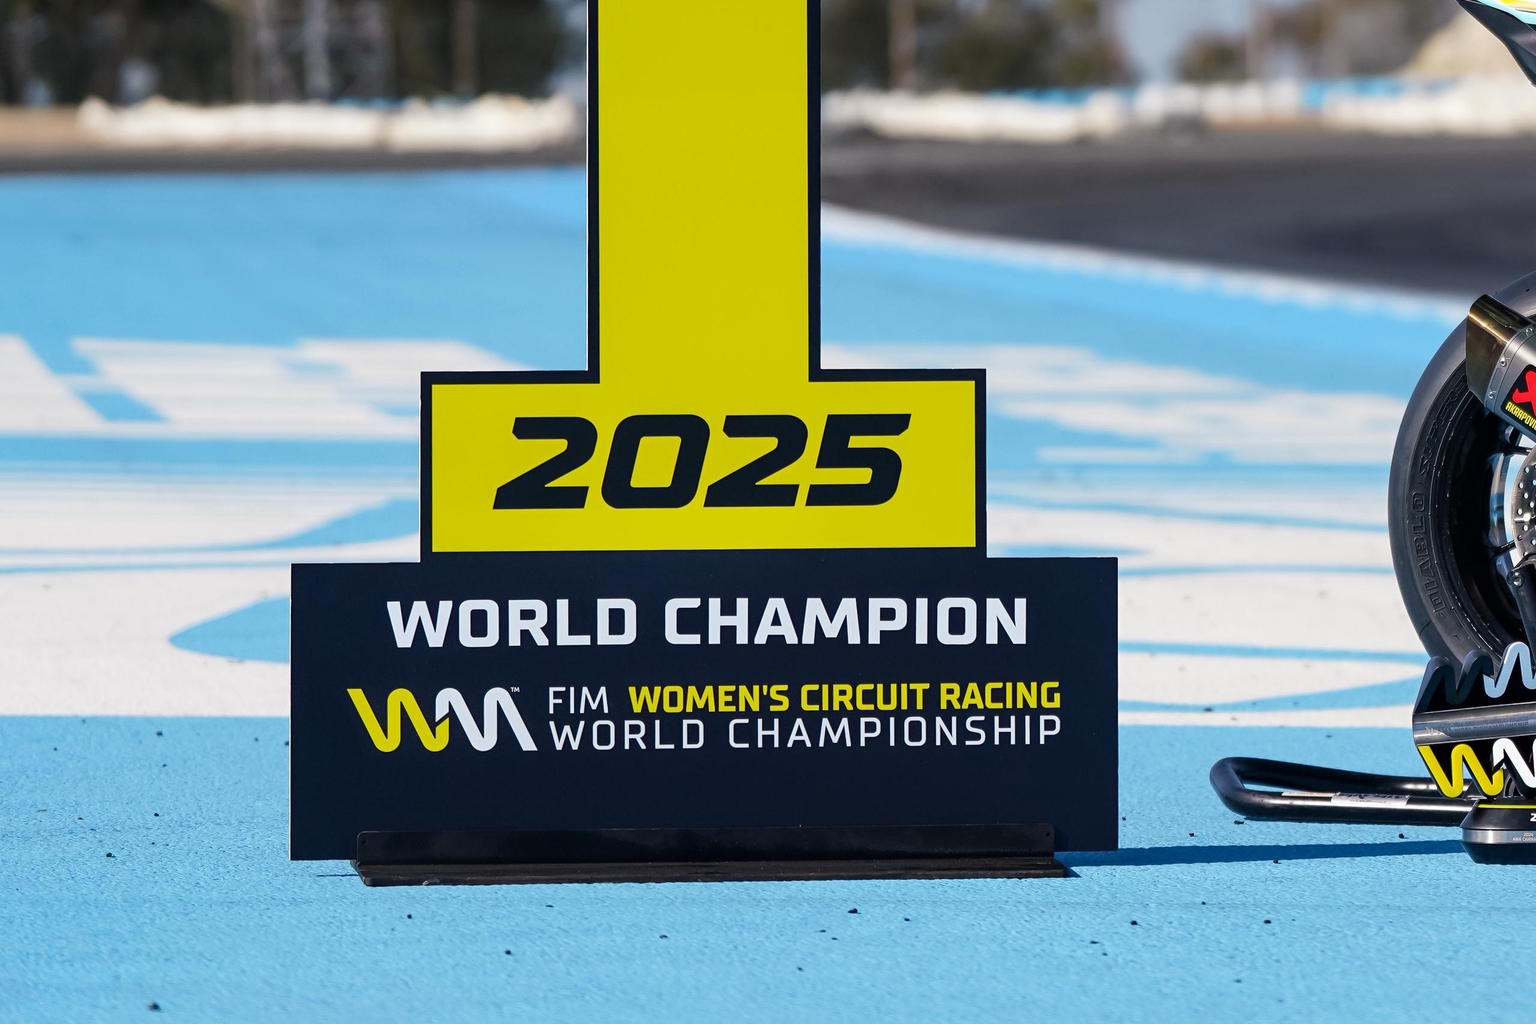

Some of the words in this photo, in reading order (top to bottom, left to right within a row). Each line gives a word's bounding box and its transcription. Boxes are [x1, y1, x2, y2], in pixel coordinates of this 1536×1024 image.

[493, 414, 911, 509] 2025
[387, 600, 636, 648] WORLD
[665, 597, 1027, 646] CHAMPION
[549, 686, 609, 715] FIM
[629, 685, 789, 713] WOMEN'S
[801, 683, 930, 711] CIRCUIT
[940, 681, 1060, 710] RACING
[549, 719, 705, 751] WORLD
[728, 715, 1061, 749] CHAMPIONSHIP
